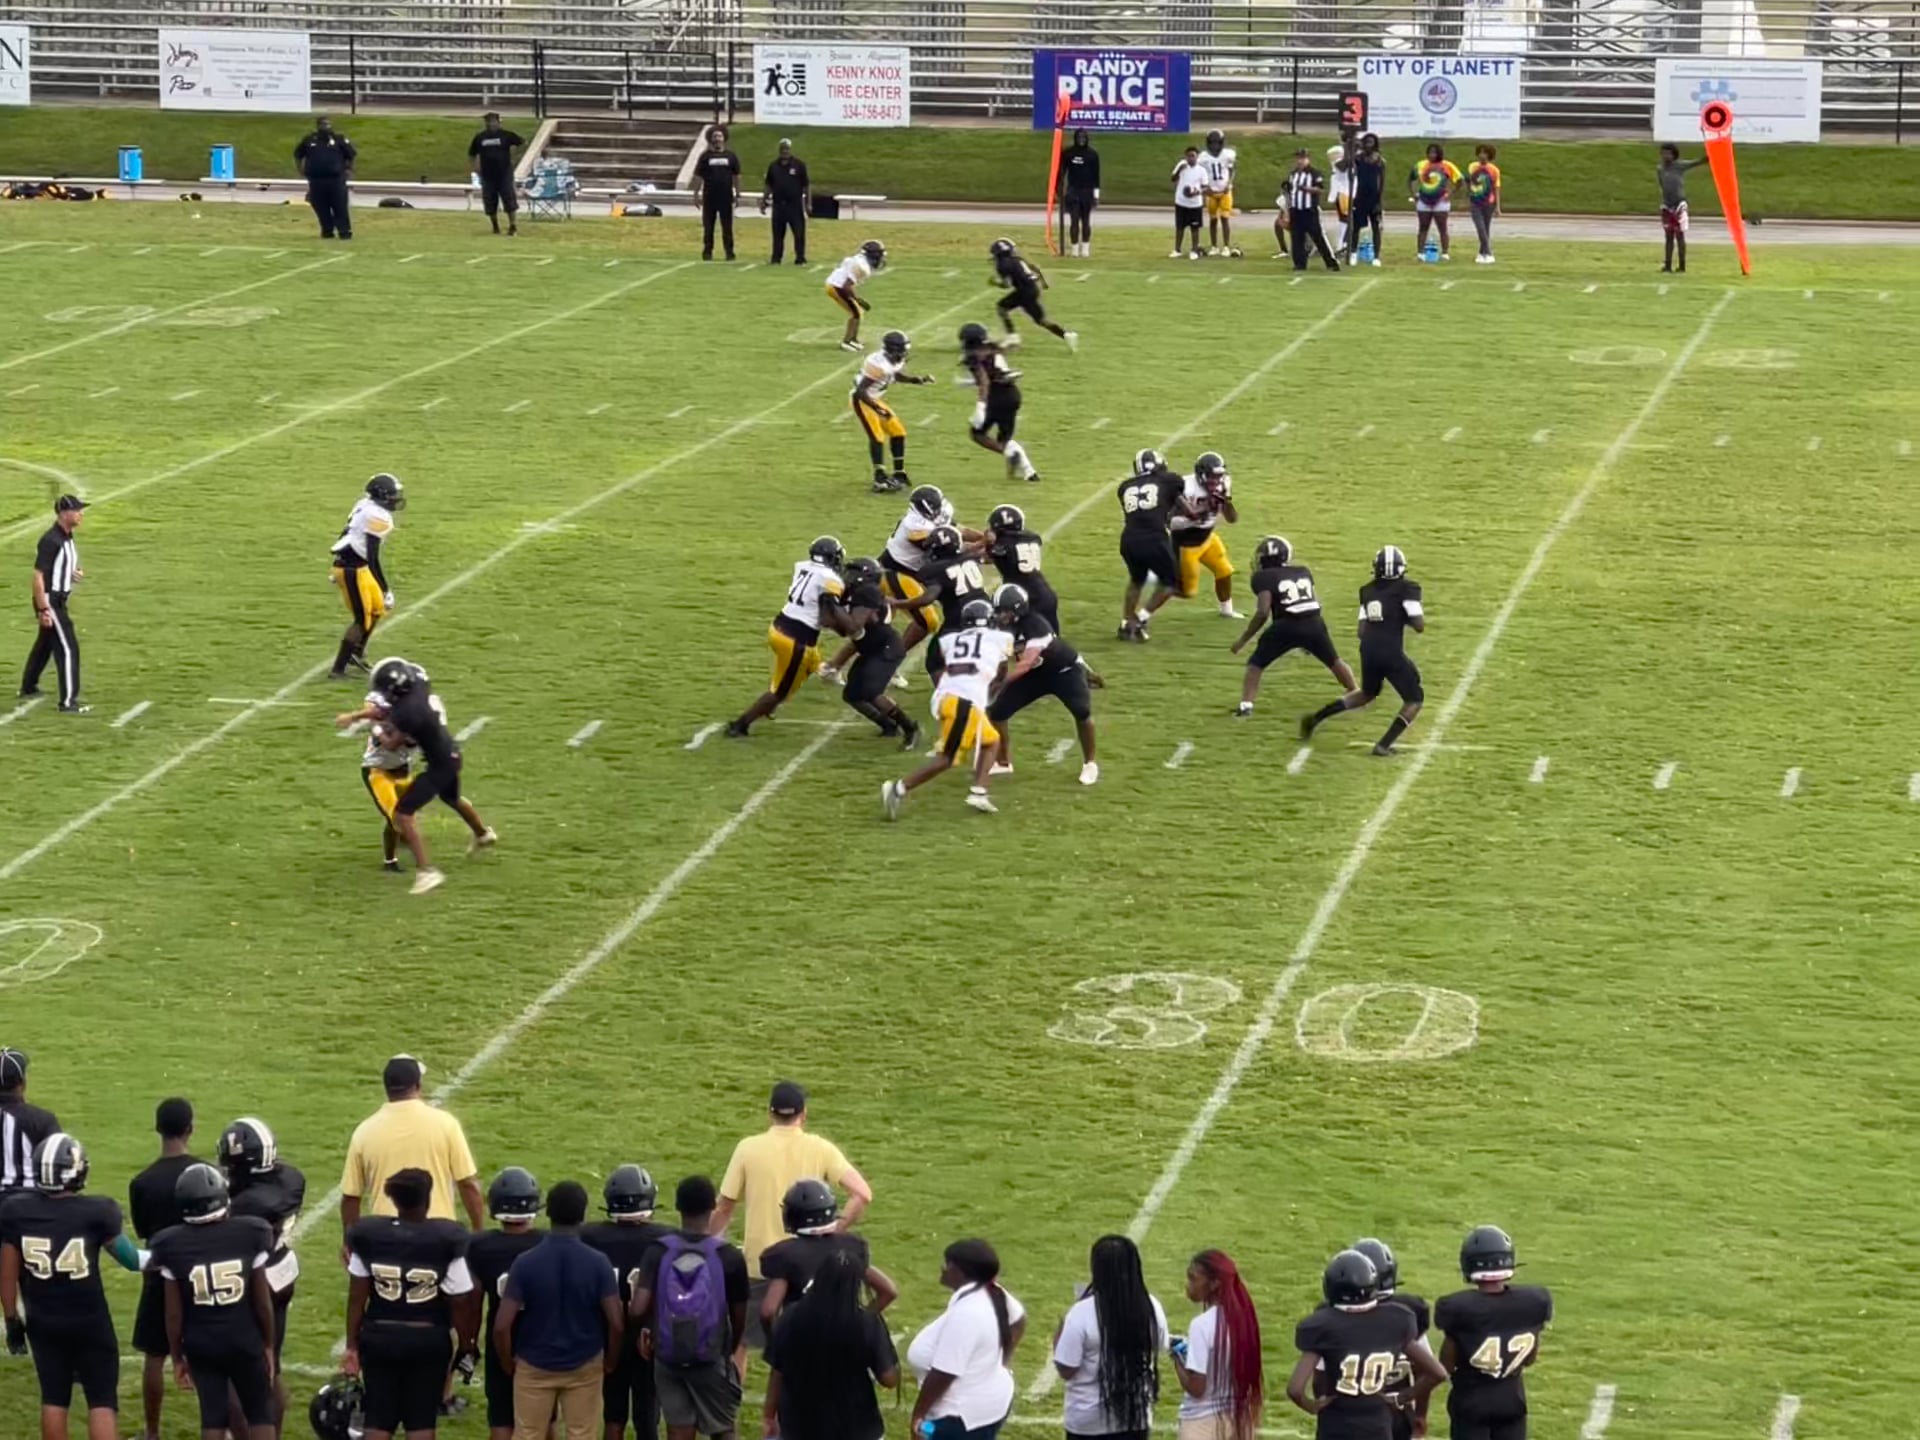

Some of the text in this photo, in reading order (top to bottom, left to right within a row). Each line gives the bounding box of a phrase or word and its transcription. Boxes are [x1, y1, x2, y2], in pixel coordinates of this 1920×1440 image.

[826, 66, 902, 80] KENNY KNOX
[1075, 58, 1149, 76] RANDY
[1363, 59, 1515, 76] CITY OF LANETT
[828, 84, 902, 100] TIRE CENTER
[1058, 75, 1165, 107] PRICE
[1070, 110, 1151, 121] STATE SENATE
[945, 559, 985, 595] 70
[953, 633, 982, 660] 51
[21, 1235, 90, 1280] 54
[189, 1259, 245, 1306] 15
[370, 1263, 438, 1303] 52
[1336, 1351, 1394, 1396] 10
